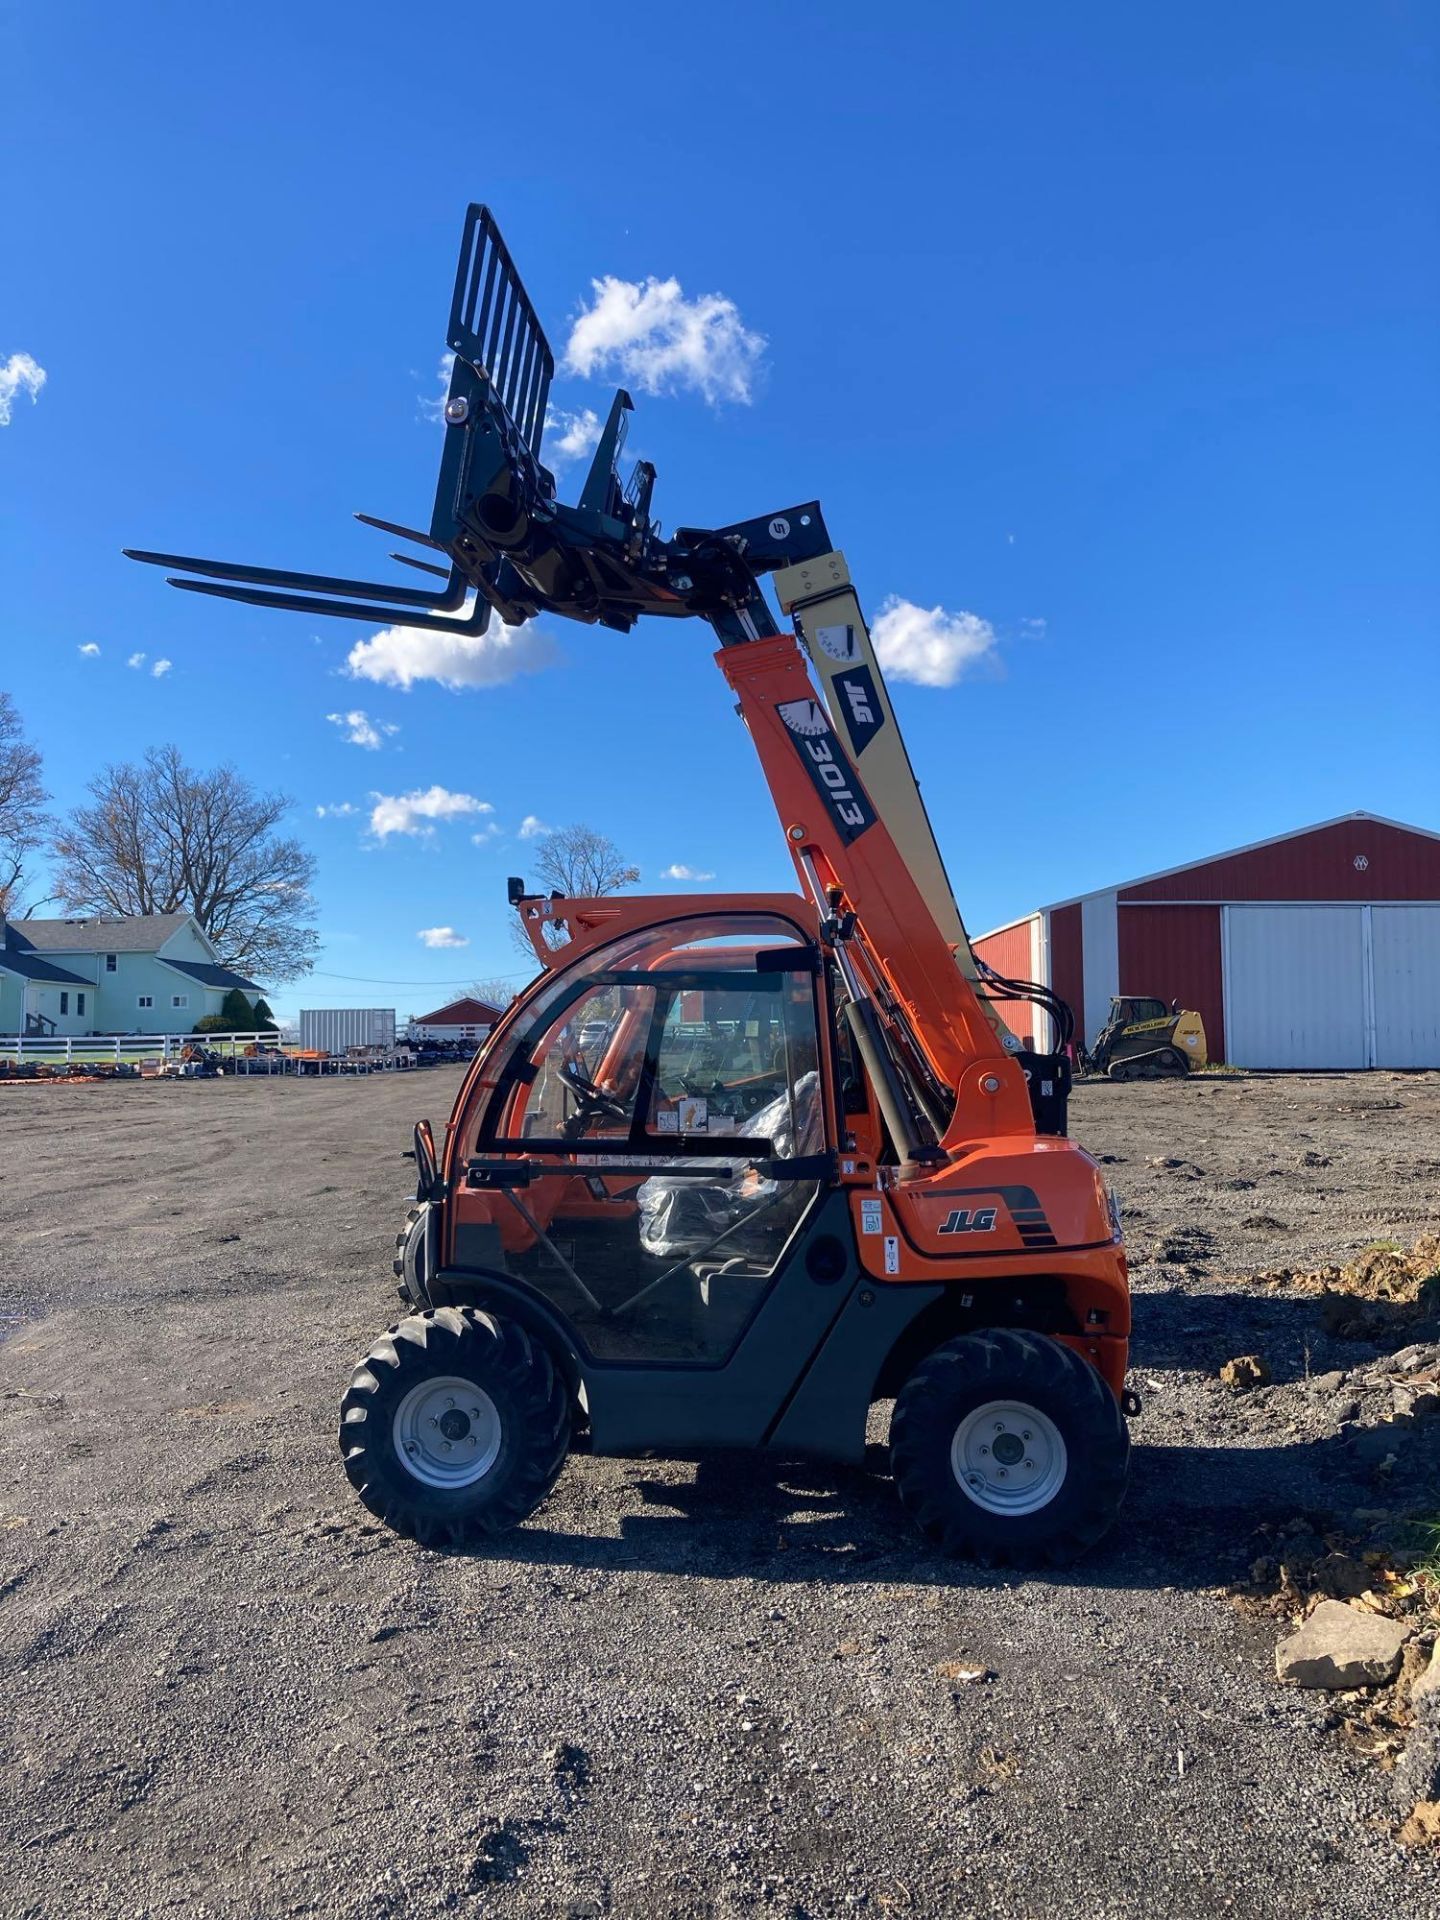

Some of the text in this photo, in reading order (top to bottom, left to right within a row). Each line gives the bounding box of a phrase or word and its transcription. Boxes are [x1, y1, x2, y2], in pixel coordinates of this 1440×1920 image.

[843, 680, 875, 725] JLG
[804, 739, 866, 826] 3013
[936, 1207, 999, 1236] JLG
